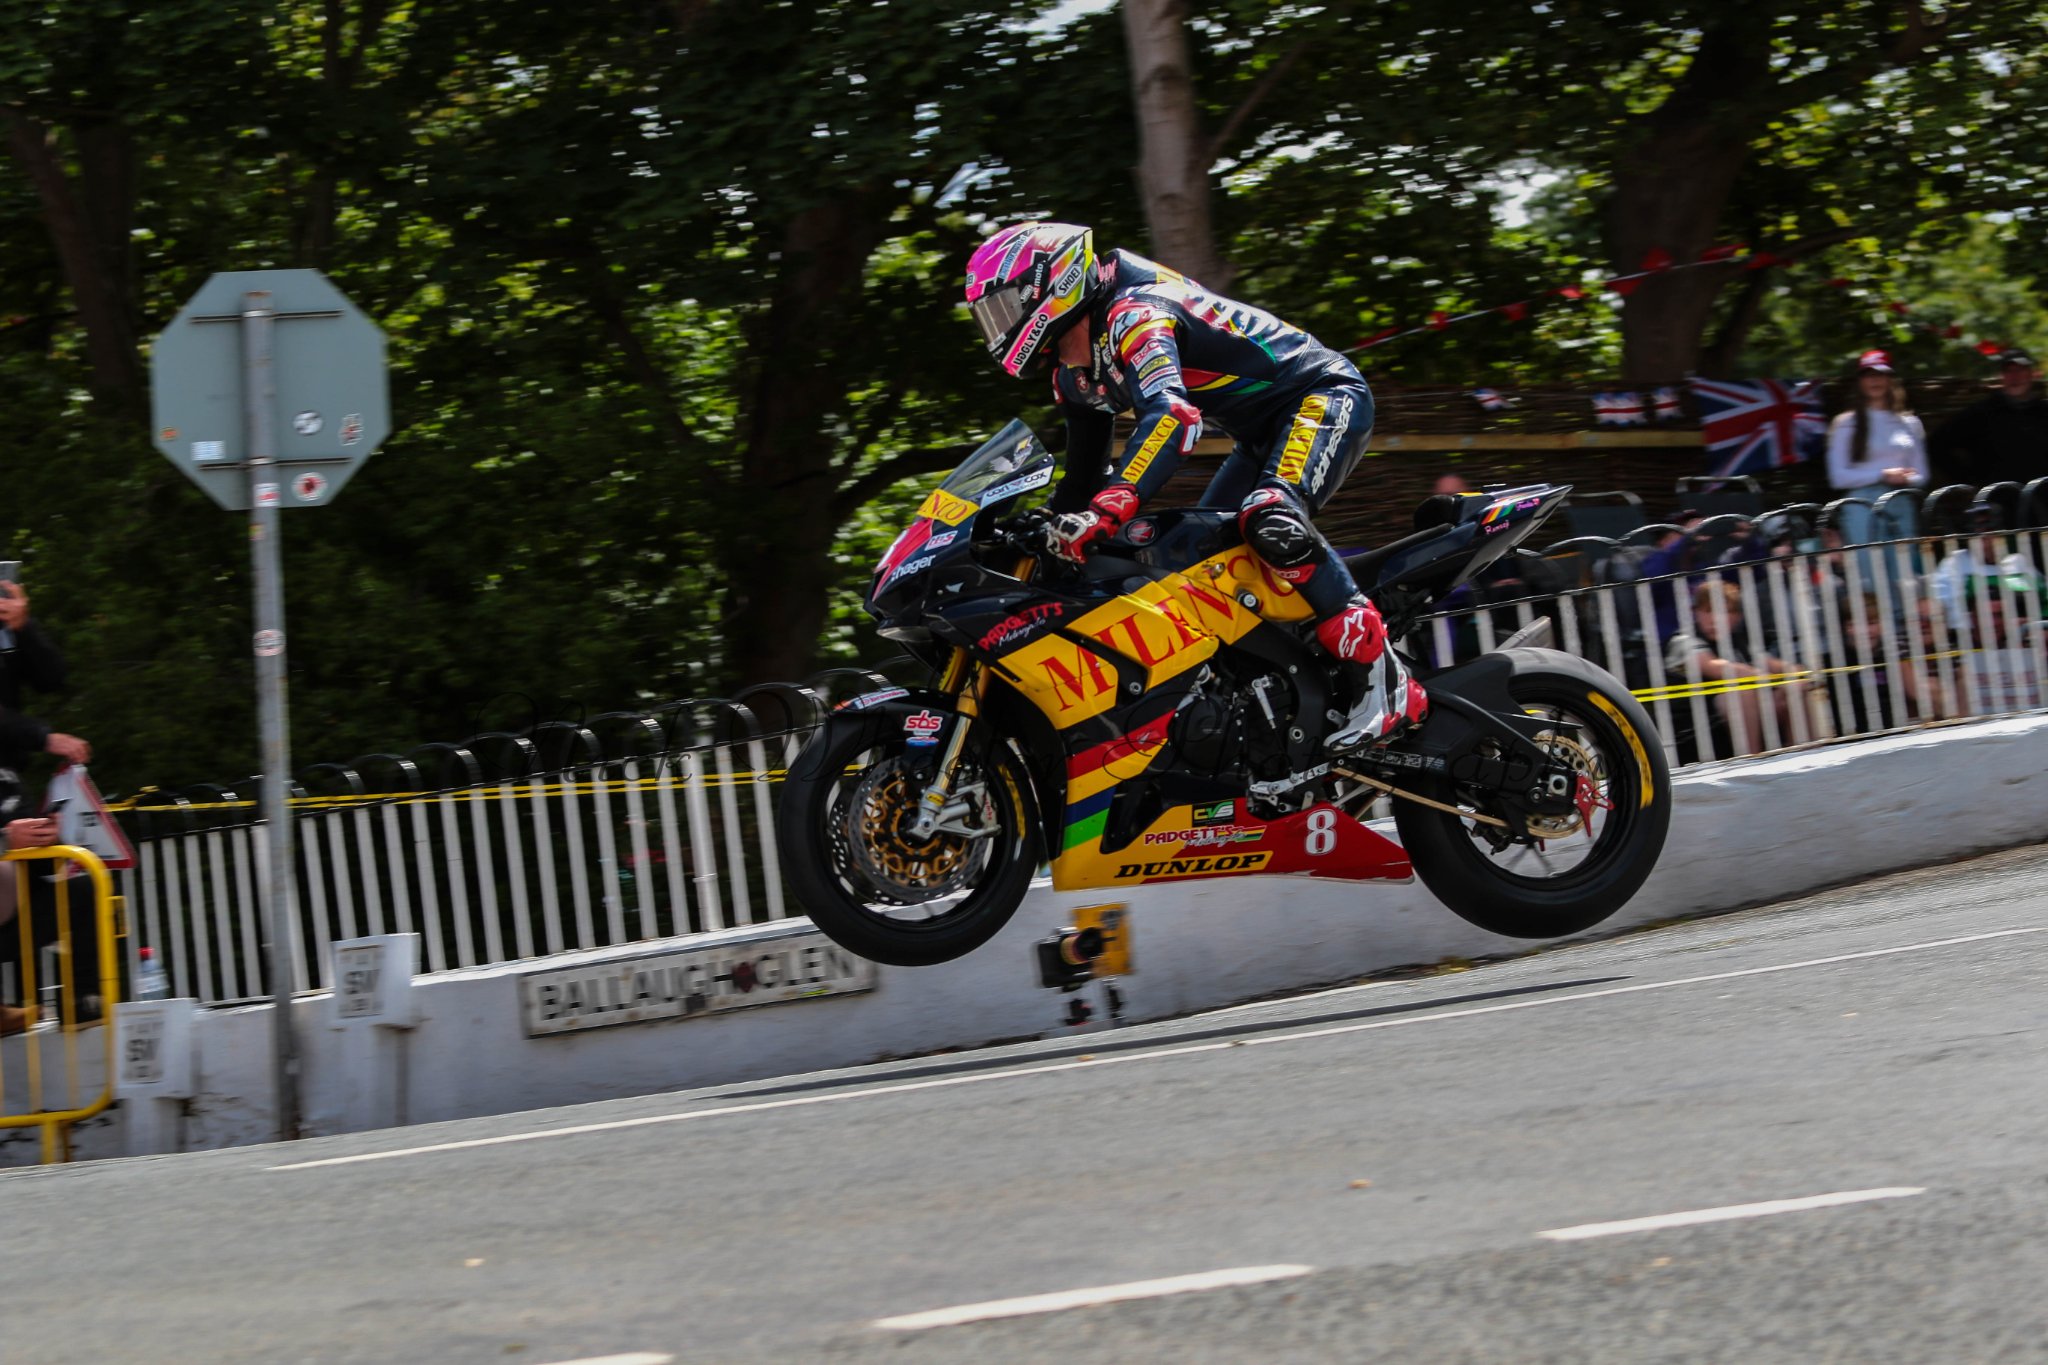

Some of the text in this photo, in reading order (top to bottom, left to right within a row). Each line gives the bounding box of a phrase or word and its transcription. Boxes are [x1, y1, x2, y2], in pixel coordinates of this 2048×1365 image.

[1059, 268, 1080, 293] SHOEI
[1124, 417, 1176, 481] MILENCO
[1311, 394, 1353, 495] alpinestars
[1024, 471, 1047, 484] cox
[905, 711, 941, 730] sbs
[1144, 825, 1234, 845] PADGETT'S
[1305, 809, 1337, 856] 8
[1114, 854, 1266, 878] DUNLOP
[537, 945, 857, 1020] BALLAUGH GLEN
